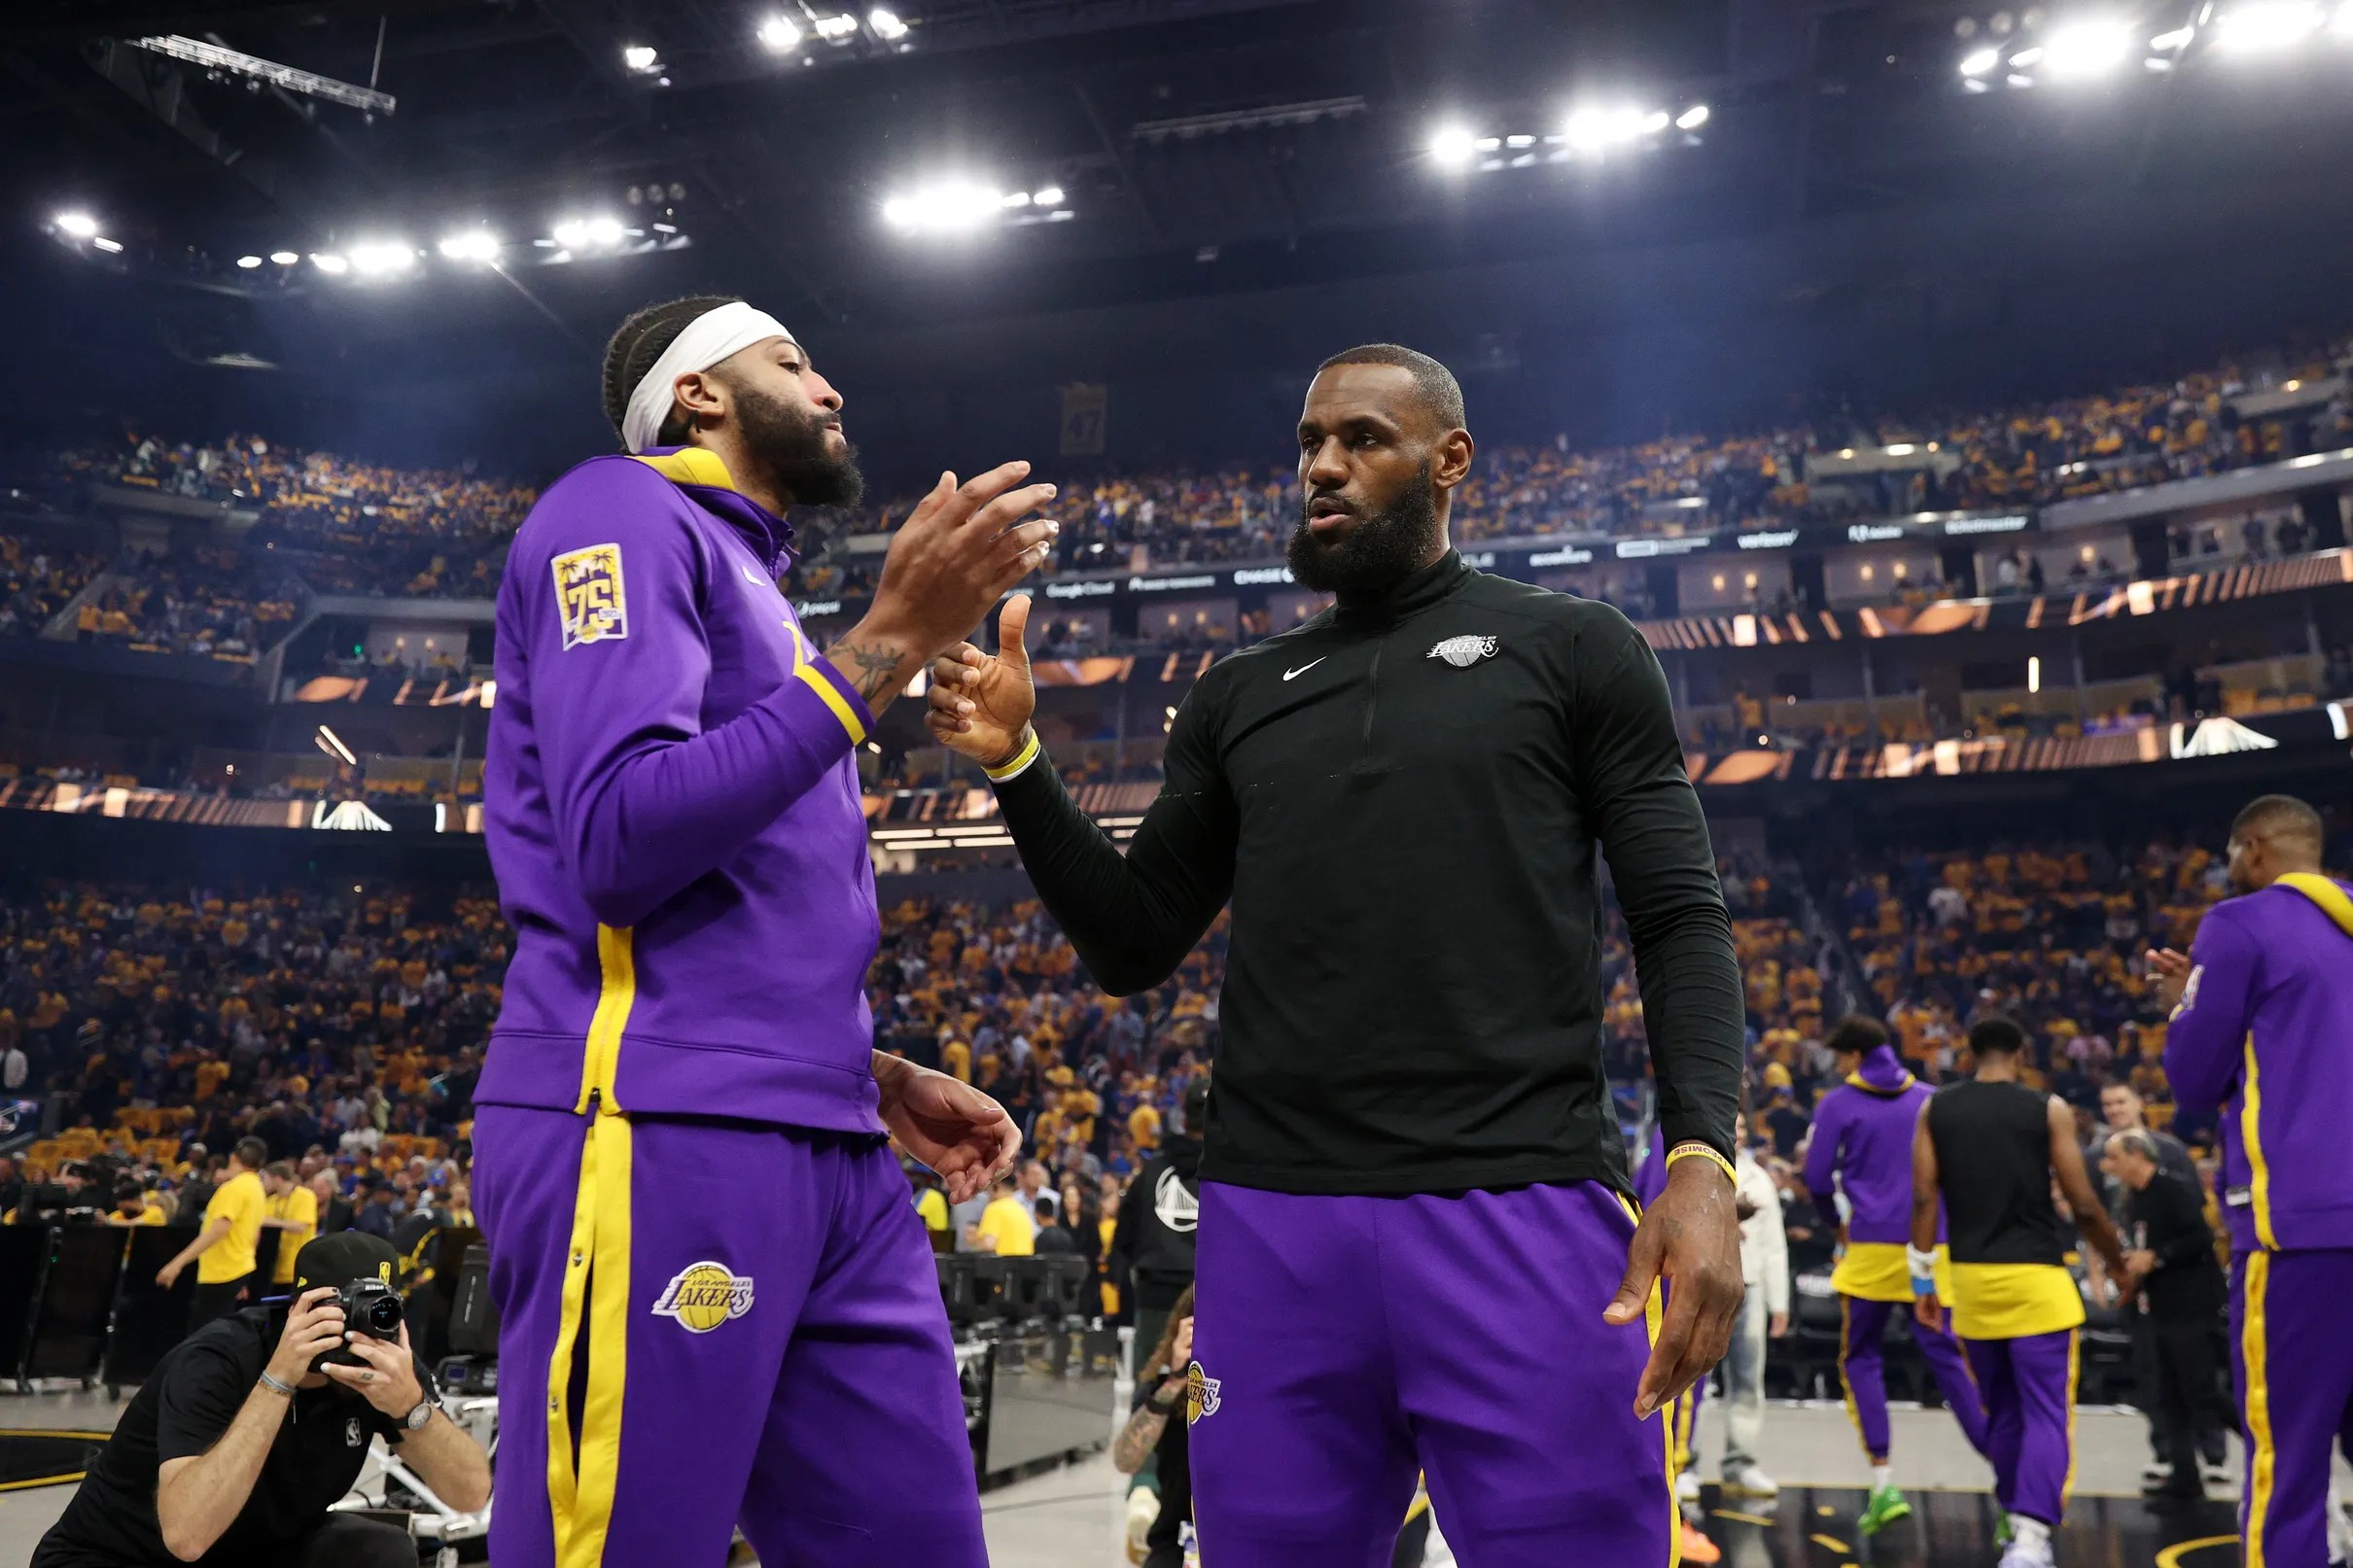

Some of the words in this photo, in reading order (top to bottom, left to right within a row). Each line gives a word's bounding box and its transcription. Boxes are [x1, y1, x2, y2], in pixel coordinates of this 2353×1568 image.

[567, 578, 615, 635] 75
[1426, 641, 1499, 657] LAKERS
[1674, 1145, 1722, 1163] PROMISE
[652, 1279, 753, 1315] LAKERS
